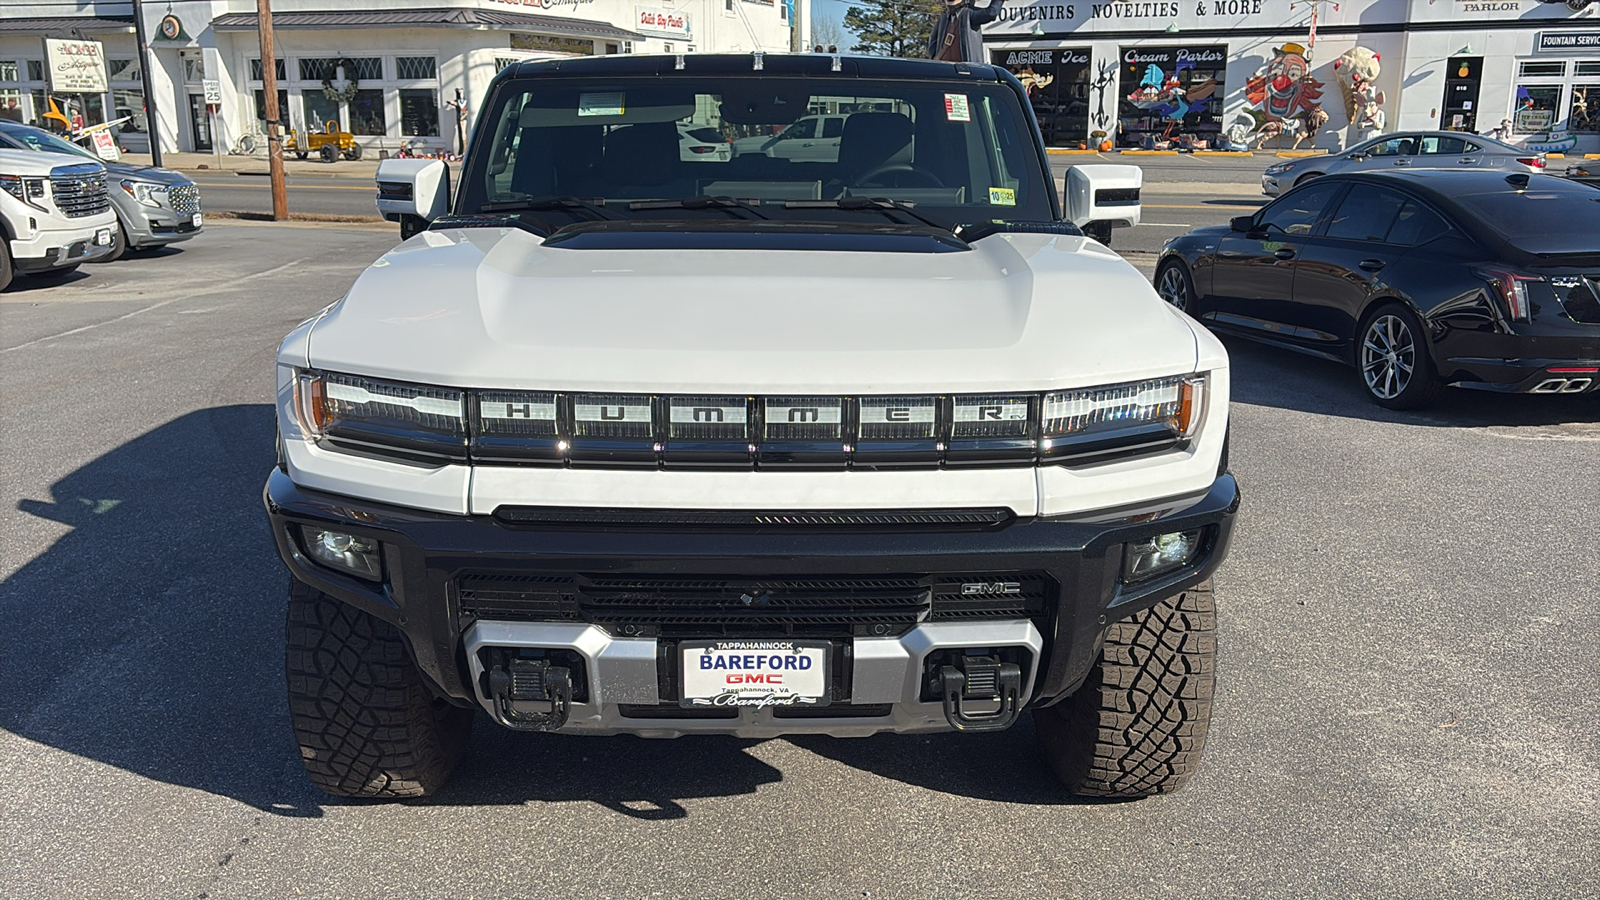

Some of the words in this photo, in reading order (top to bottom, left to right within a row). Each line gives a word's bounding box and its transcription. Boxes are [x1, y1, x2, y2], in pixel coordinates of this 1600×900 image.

[999, 5, 1075, 21] OUVENIRS
[1092, 2, 1178, 18] NOVELTIES
[1196, 0, 1207, 16] &
[1214, 0, 1262, 15] MORE
[1464, 2, 1520, 12] PARLOR
[641, 12, 655, 24] Dutch
[657, 14, 667, 29] Boy
[668, 15, 683, 28] Paints
[1543, 36, 1576, 45] FOUNTAIN
[1577, 36, 1600, 45] SERVIC
[1006, 51, 1053, 64] ACME
[1061, 50, 1089, 64] Ice
[1124, 49, 1170, 63] Cream
[1176, 49, 1224, 62] Parlor
[207, 92, 220, 101] 25
[991, 191, 999, 201] 10
[1006, 192, 1013, 200] 25
[506, 403, 1003, 422] HUMMER
[961, 582, 1020, 594] GMC
[716, 642, 793, 650] TAPPAHANNOCK
[700, 655, 812, 670] BAREFORD
[725, 674, 783, 684] GMC
[713, 693, 799, 709] Bareford
